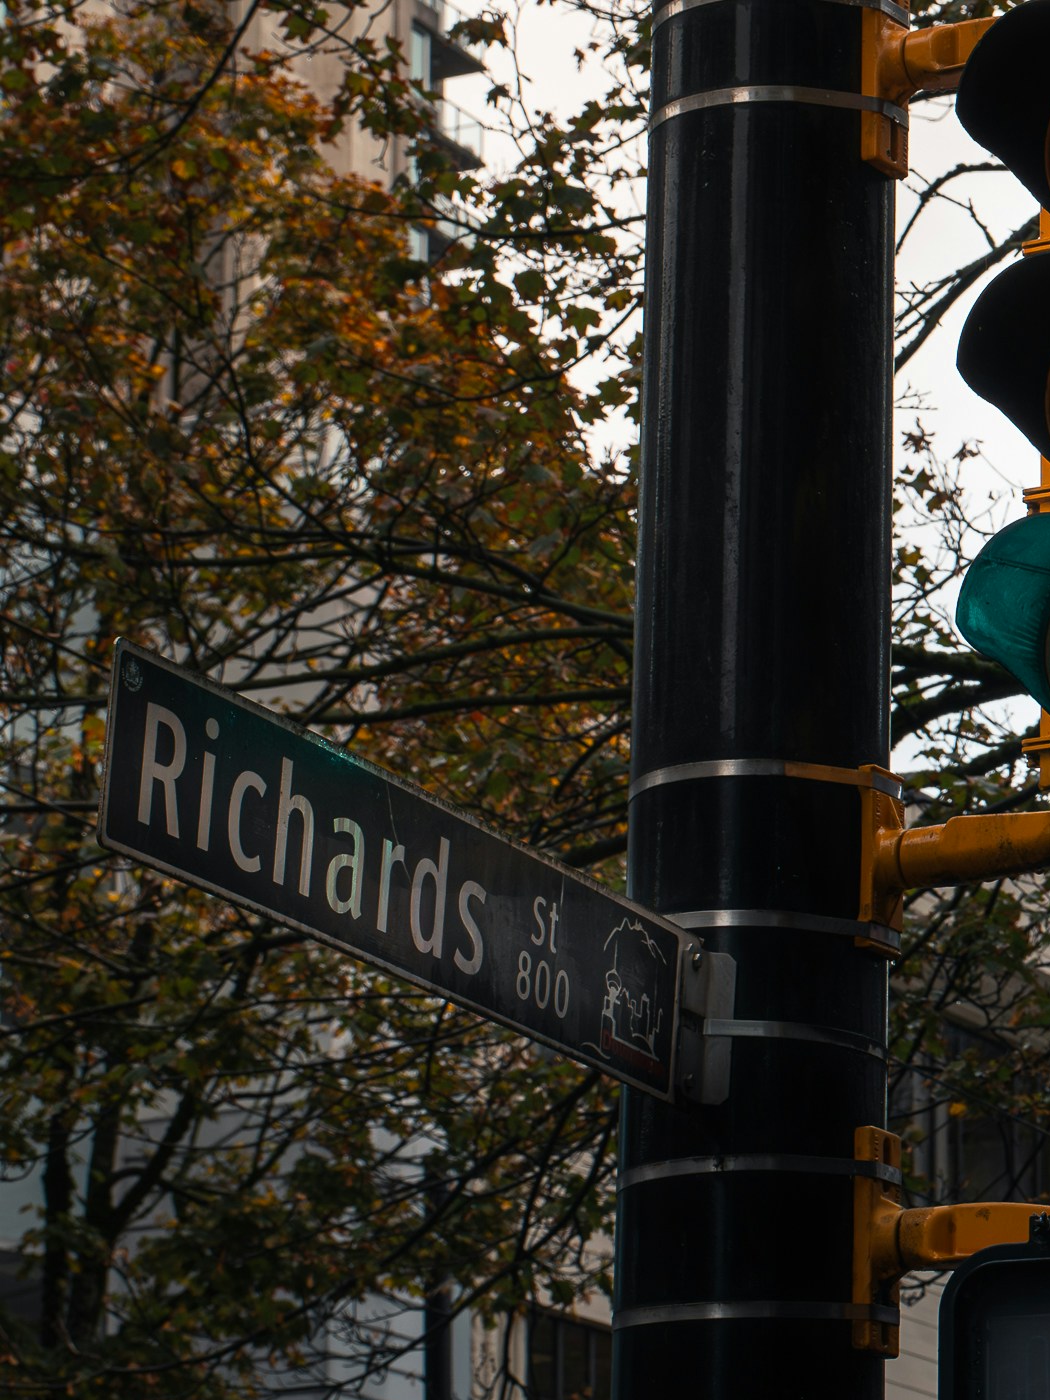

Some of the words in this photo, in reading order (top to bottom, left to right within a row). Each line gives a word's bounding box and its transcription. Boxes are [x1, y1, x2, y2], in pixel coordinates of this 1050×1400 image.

[136, 701, 487, 976] Richards
[530, 895, 559, 954] St
[516, 950, 570, 1019] 800
